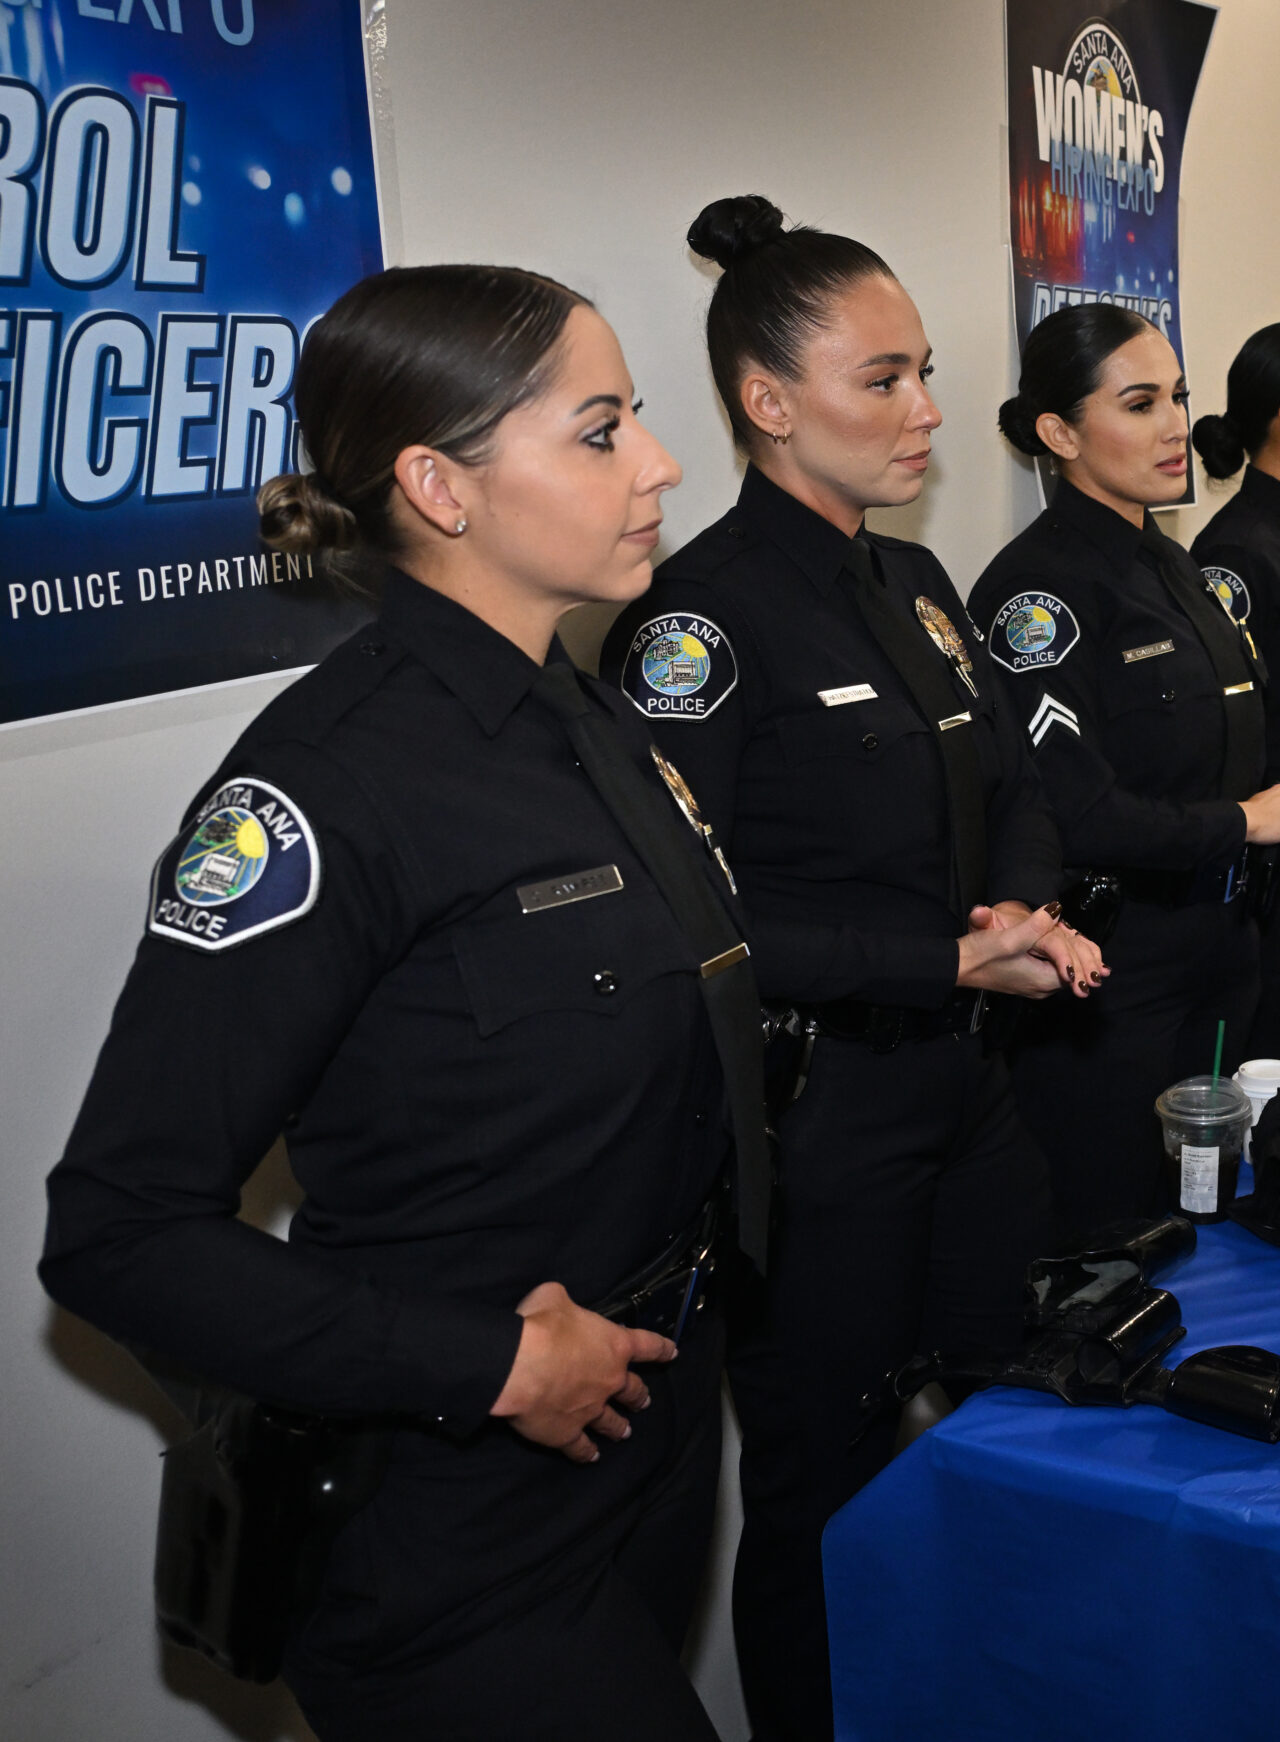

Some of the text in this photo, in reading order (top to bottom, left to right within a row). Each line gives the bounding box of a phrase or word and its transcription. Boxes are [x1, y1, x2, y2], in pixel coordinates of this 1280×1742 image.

[1073, 31, 1133, 94] SANTA ANA
[1032, 65, 1165, 194] WOMEN'S
[1050, 139, 1155, 217] HIRING EXPO
[8, 551, 314, 619] POLICE DEPARTMENT
[1204, 570, 1243, 595] NTA ANA
[997, 596, 1062, 626] SANTA ANA
[632, 618, 721, 653] SANTA ANA
[1013, 651, 1056, 668] POLICE
[647, 697, 705, 713] POLICE
[256, 801, 302, 851] ANA
[155, 898, 228, 939] POLICE
